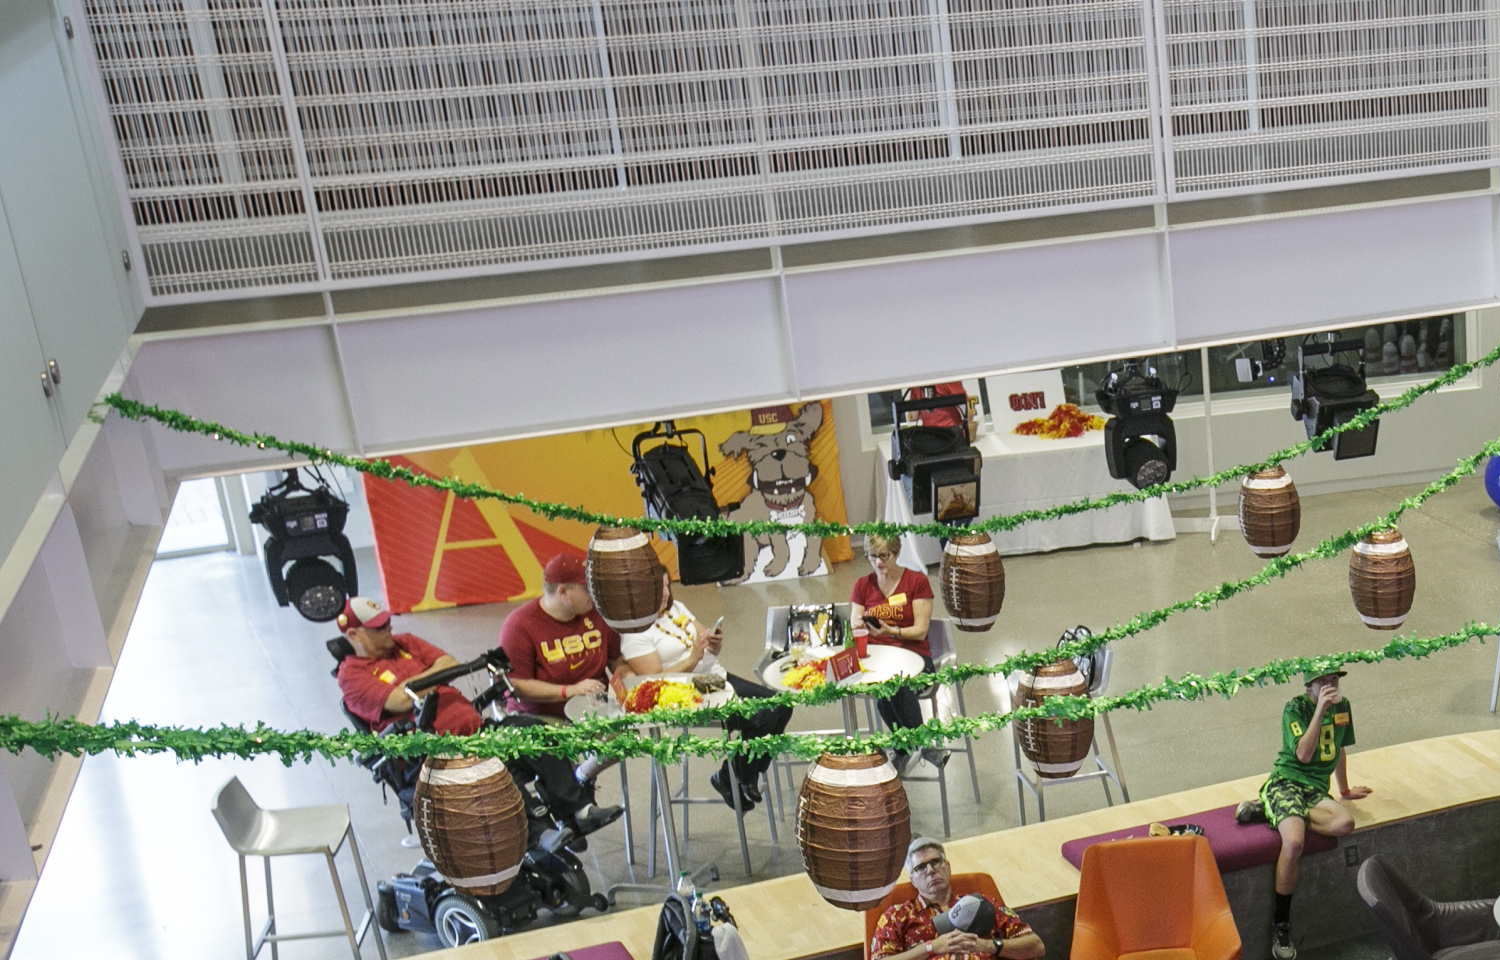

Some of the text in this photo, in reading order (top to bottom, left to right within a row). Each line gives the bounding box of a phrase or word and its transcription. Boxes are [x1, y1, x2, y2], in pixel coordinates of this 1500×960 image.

[758, 412, 778, 424] USC
[411, 447, 548, 612] A
[540, 629, 602, 663] USC
[1290, 721, 1303, 737] 8
[1319, 724, 1336, 762] 8
